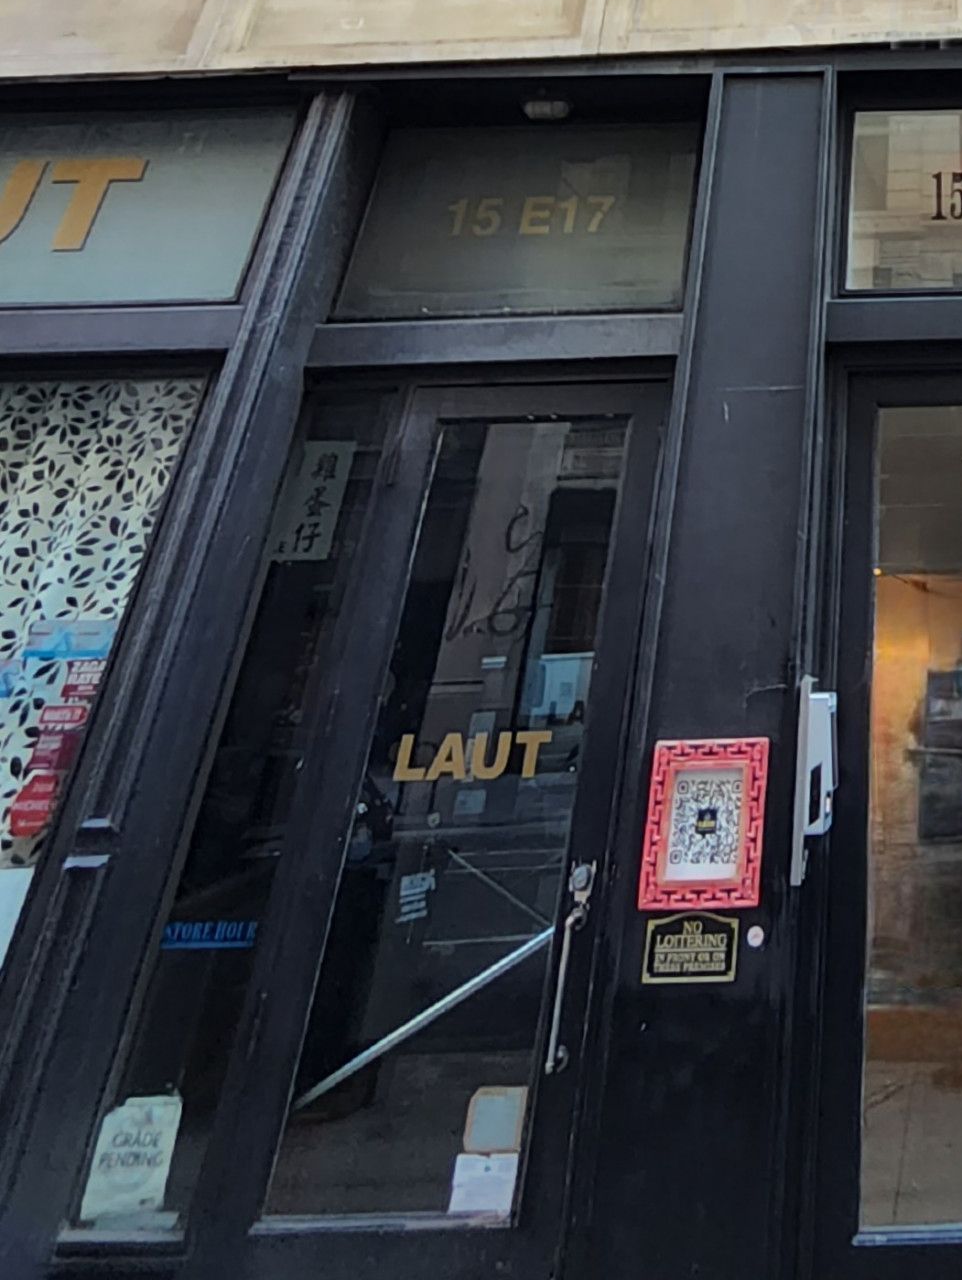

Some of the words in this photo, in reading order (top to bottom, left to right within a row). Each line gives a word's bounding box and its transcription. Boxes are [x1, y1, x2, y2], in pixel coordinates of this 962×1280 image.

[447, 198, 502, 238] 15
[518, 195, 617, 236] E17
[392, 730, 553, 782] LAUT
[682, 920, 703, 935] NO
[656, 933, 728, 949] LOITERING
[112, 1129, 162, 1148] GRADE
[98, 1151, 164, 1169] PENDING
